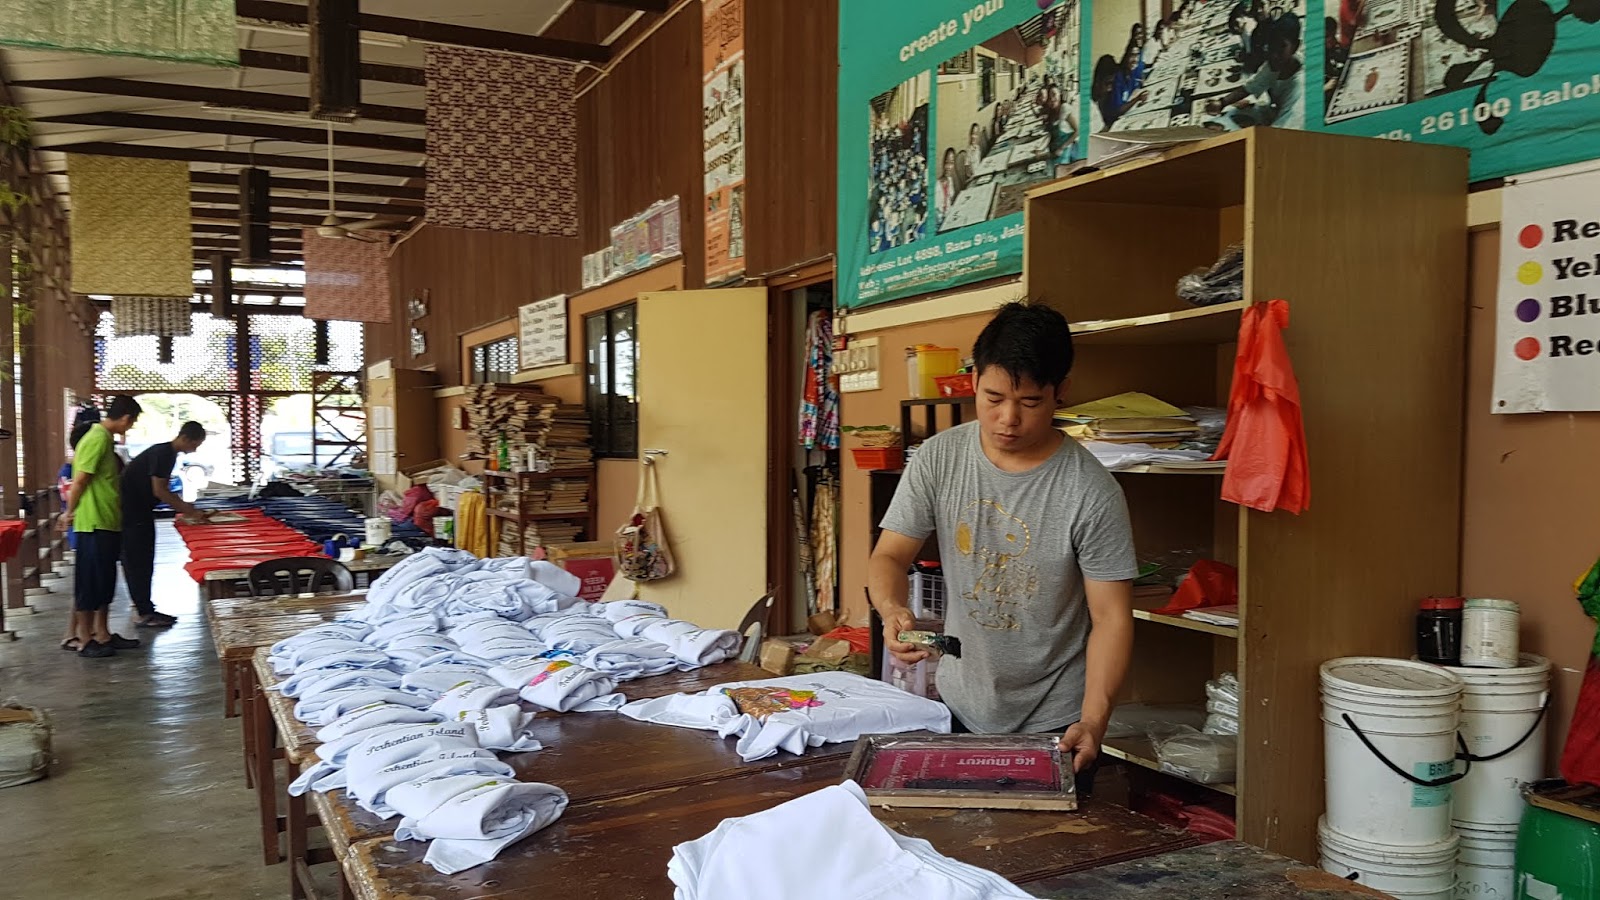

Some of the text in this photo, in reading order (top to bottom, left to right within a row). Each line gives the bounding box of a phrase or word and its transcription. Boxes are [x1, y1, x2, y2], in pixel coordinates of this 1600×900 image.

[899, 19, 958, 62] create
[1421, 97, 1511, 135] 26100
[897, 255, 912, 266] Lot
[945, 239, 972, 253] Batu
[1549, 335, 1600, 358] Re
[366, 727, 466, 756] Perhentian Island
